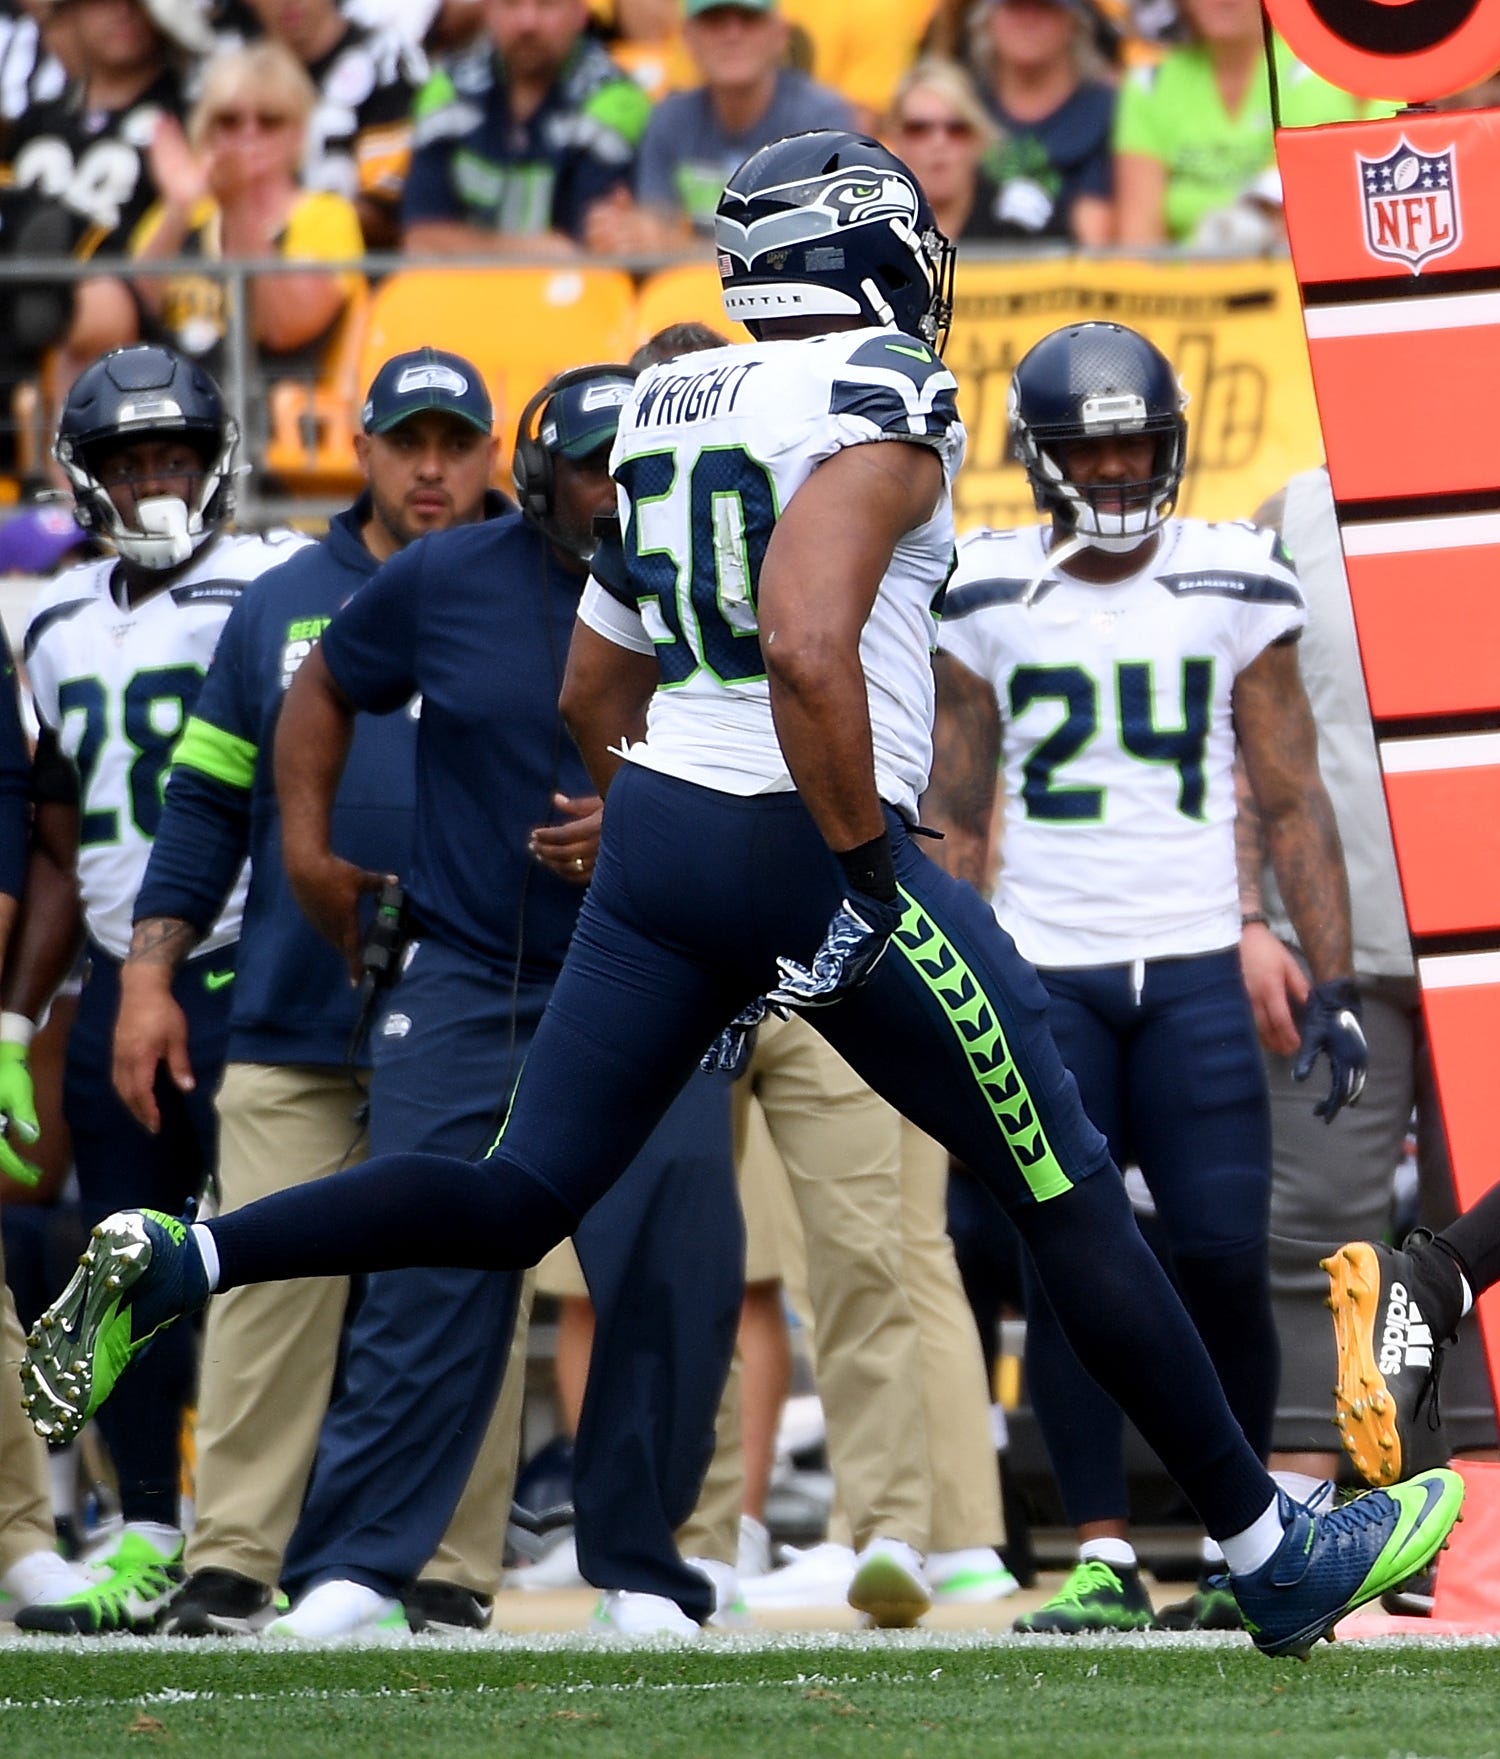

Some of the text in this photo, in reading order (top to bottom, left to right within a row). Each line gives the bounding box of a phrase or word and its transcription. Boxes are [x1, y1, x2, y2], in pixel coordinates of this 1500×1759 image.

[1374, 196, 1449, 252] NFL
[635, 361, 765, 428] WRIGHT
[610, 442, 780, 692] 50
[57, 661, 208, 847] 28
[1007, 655, 1217, 824] 24
[1378, 1281, 1411, 1376] adidas
